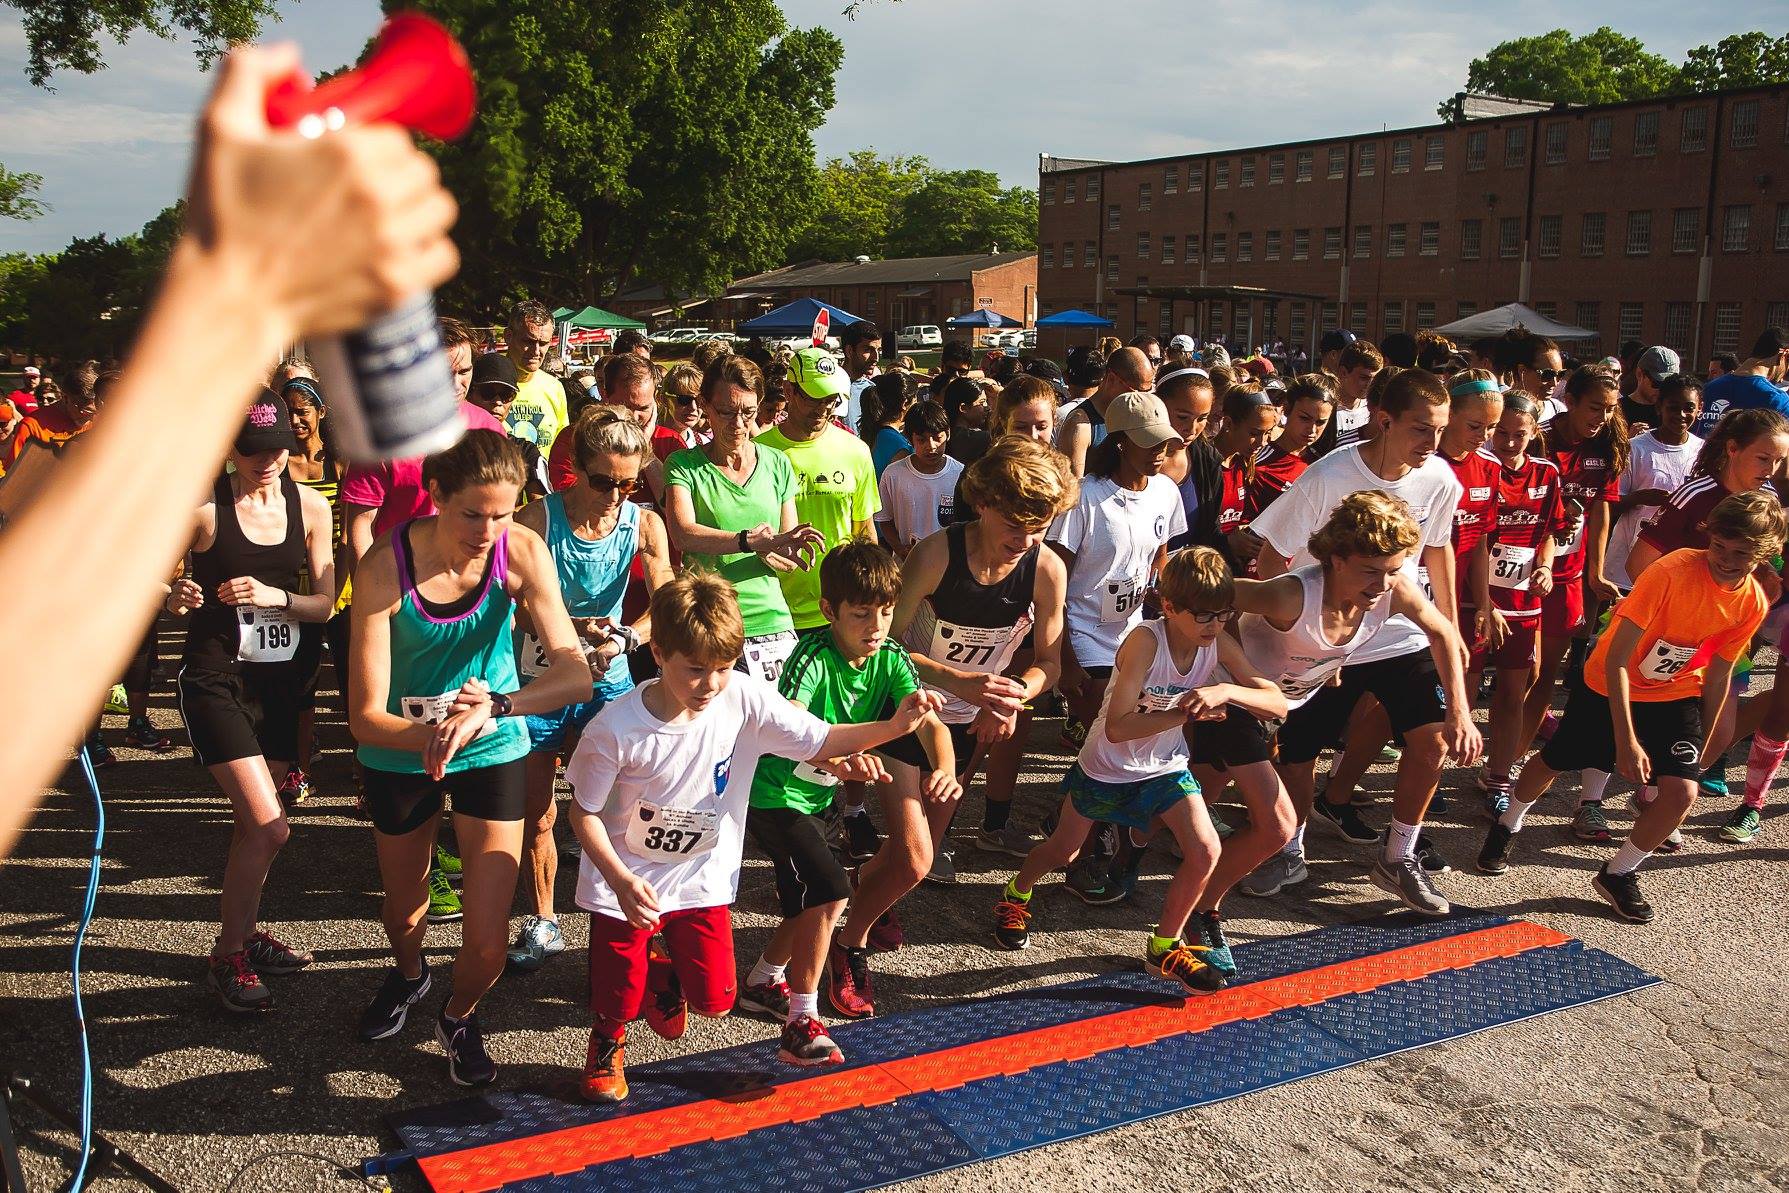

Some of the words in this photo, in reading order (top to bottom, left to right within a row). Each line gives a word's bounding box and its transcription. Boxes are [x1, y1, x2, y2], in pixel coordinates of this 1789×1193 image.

[1495, 560, 1524, 580] 371
[256, 623, 291, 650] 199
[946, 642, 996, 665] 277
[645, 827, 702, 854] 337
